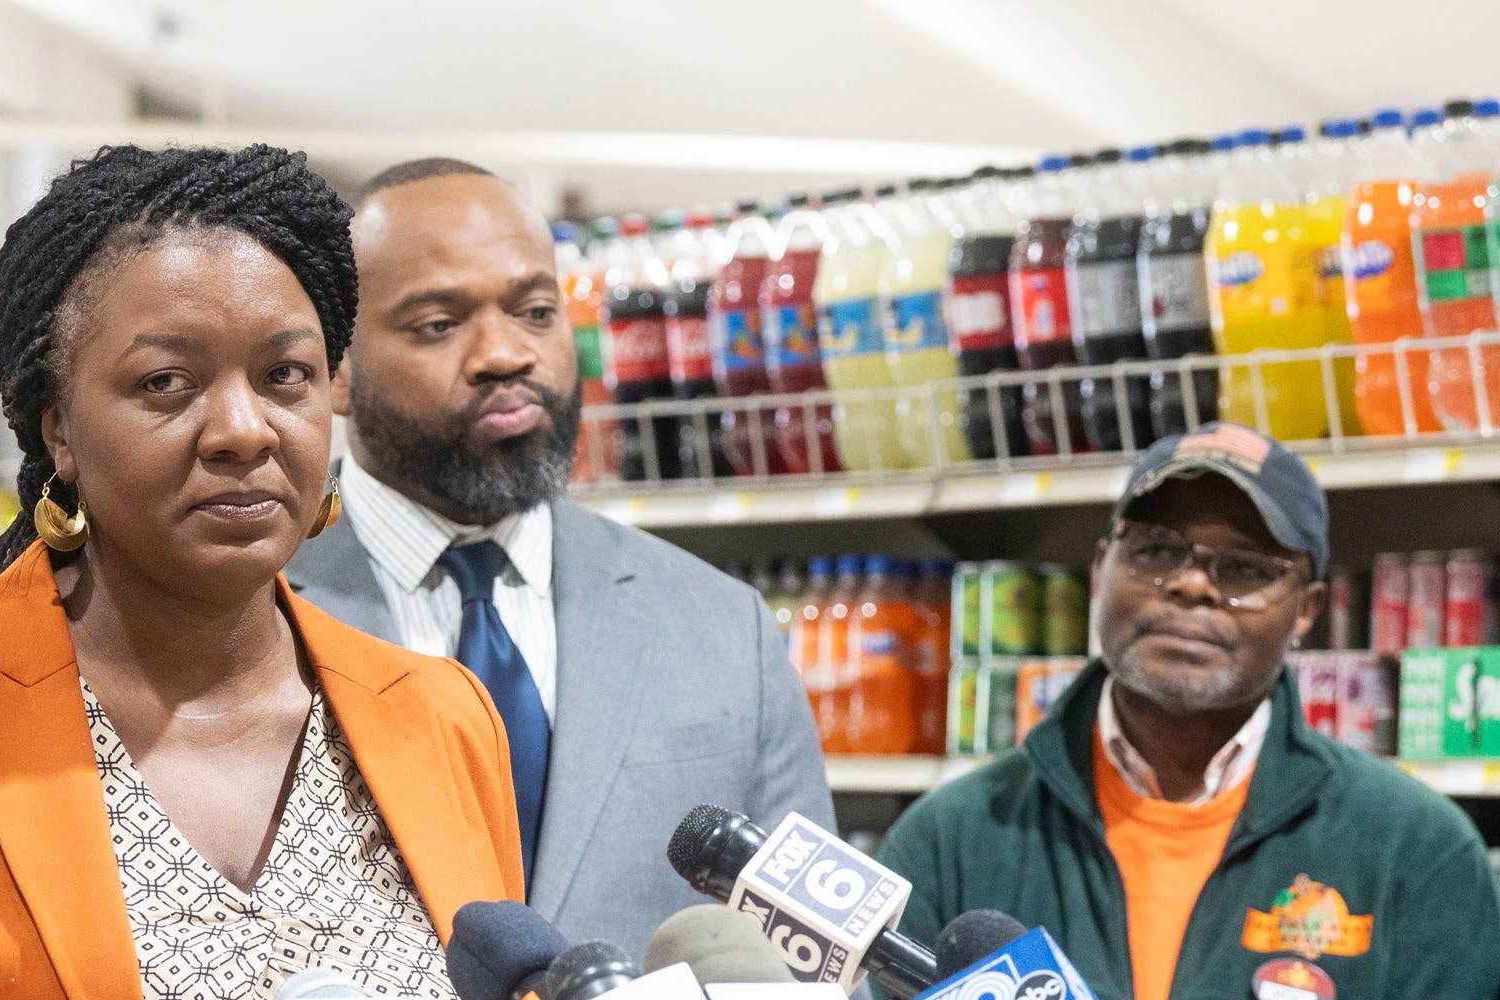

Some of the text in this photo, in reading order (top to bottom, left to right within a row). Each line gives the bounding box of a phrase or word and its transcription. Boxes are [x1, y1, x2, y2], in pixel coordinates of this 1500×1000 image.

[761, 830, 819, 885] FOX
[805, 859, 866, 910] 6
[846, 880, 897, 934] NEWS
[820, 945, 848, 983] EWS
